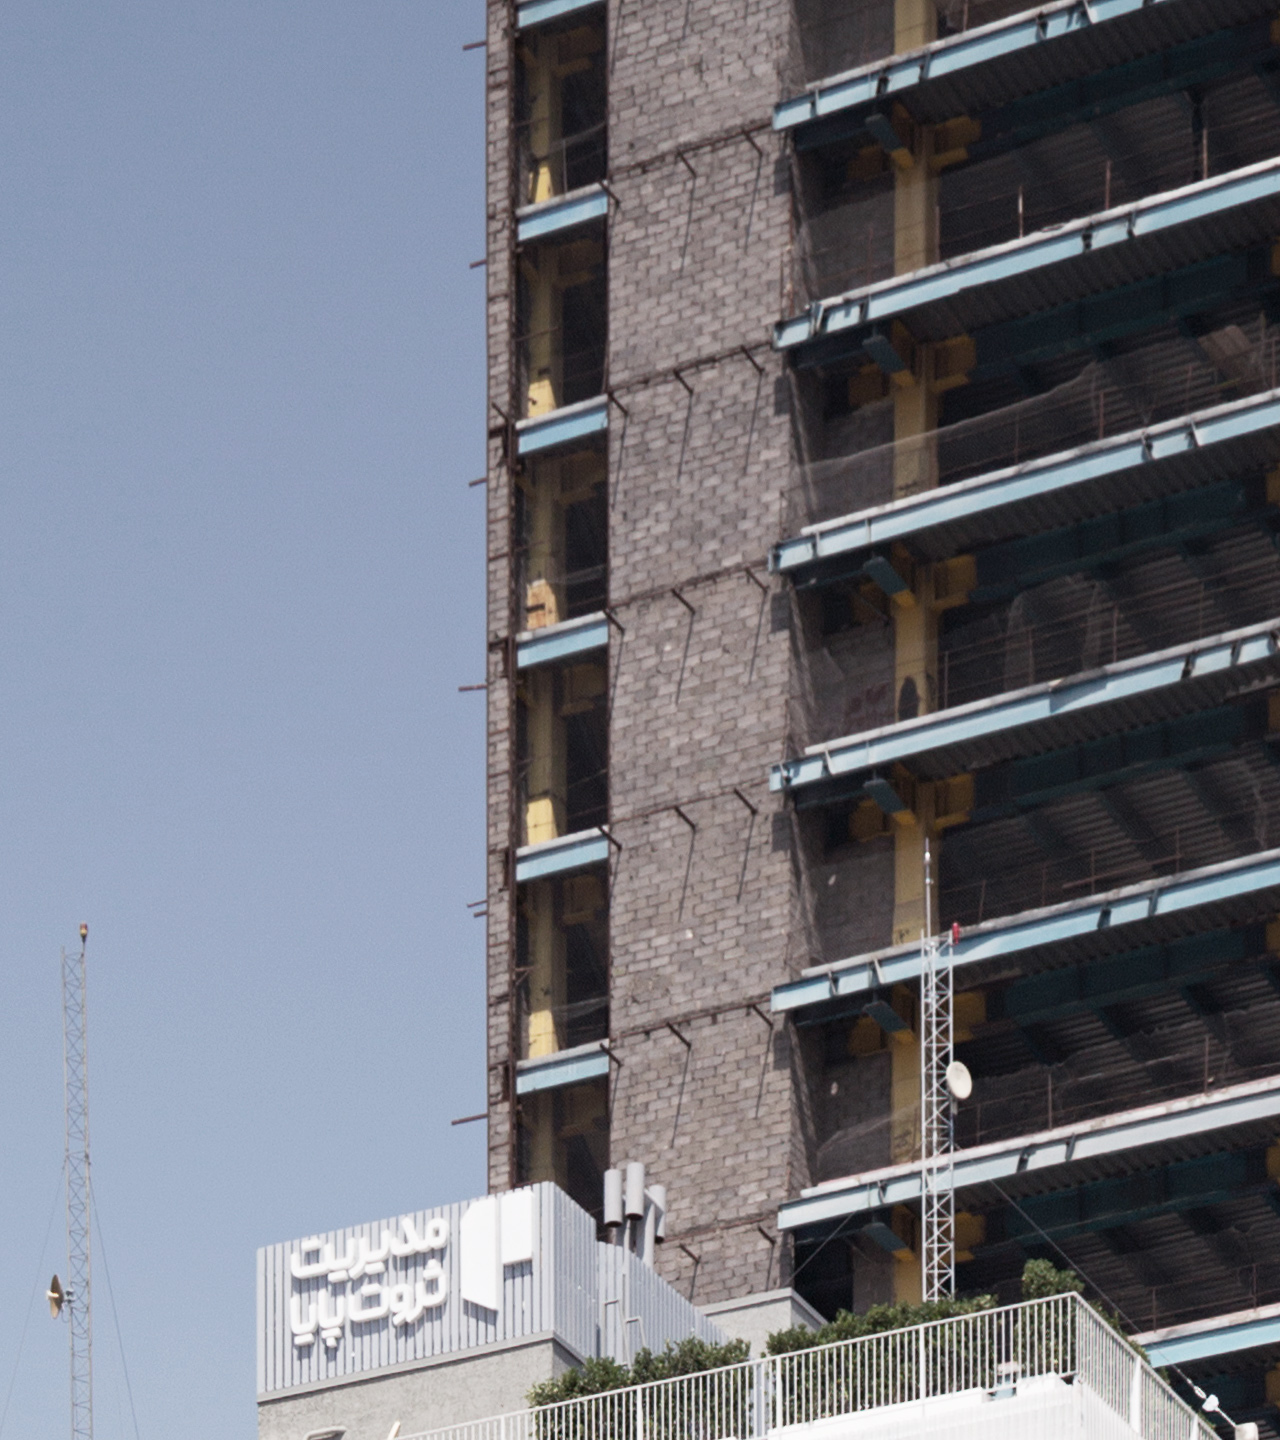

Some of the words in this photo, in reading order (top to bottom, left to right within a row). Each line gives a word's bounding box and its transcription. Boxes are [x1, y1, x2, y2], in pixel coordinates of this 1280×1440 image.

[290, 1216, 449, 1284] مدیریت
[290, 1286, 346, 1348] پایا
[348, 1259, 448, 1328] ثروت
